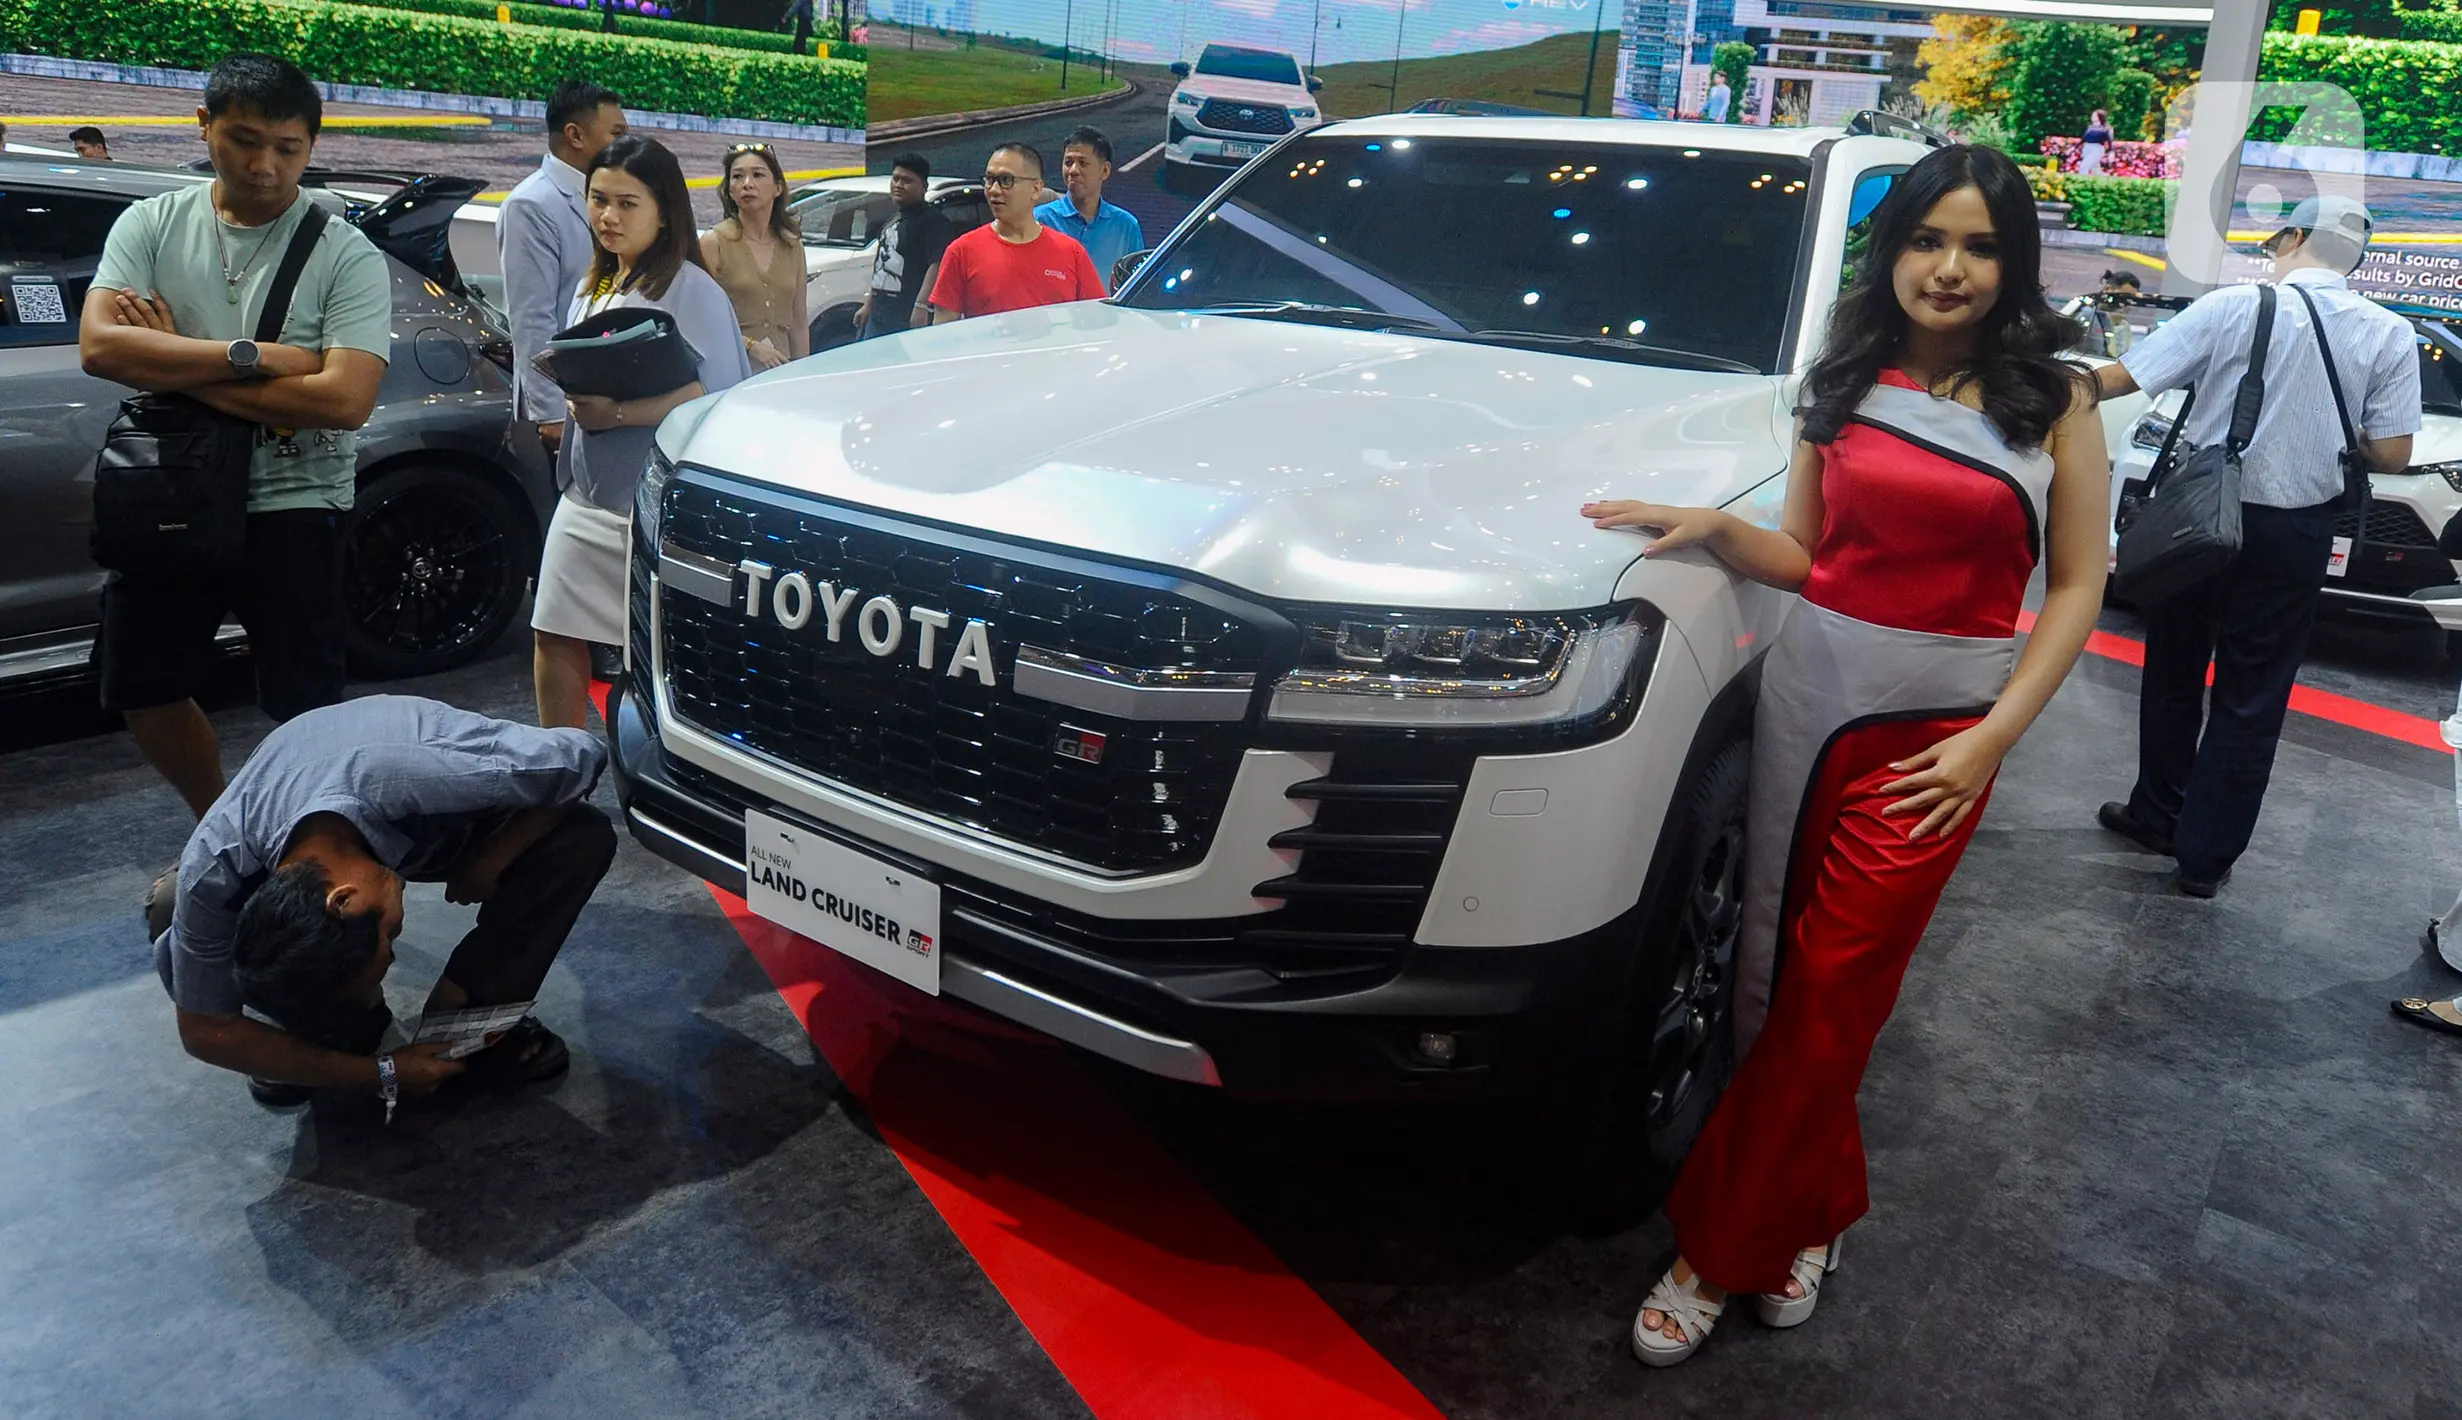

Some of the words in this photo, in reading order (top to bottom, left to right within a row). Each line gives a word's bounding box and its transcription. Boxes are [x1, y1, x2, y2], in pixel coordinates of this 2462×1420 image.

[2405, 255, 2460, 270] source
[2395, 269, 2415, 288] by
[738, 559, 996, 687] TOYOTA
[750, 846, 767, 861] ALL
[769, 852, 792, 870] NEW
[751, 861, 806, 901] LAND
[811, 888, 901, 945] CRUISER
[907, 931, 932, 953] GR
